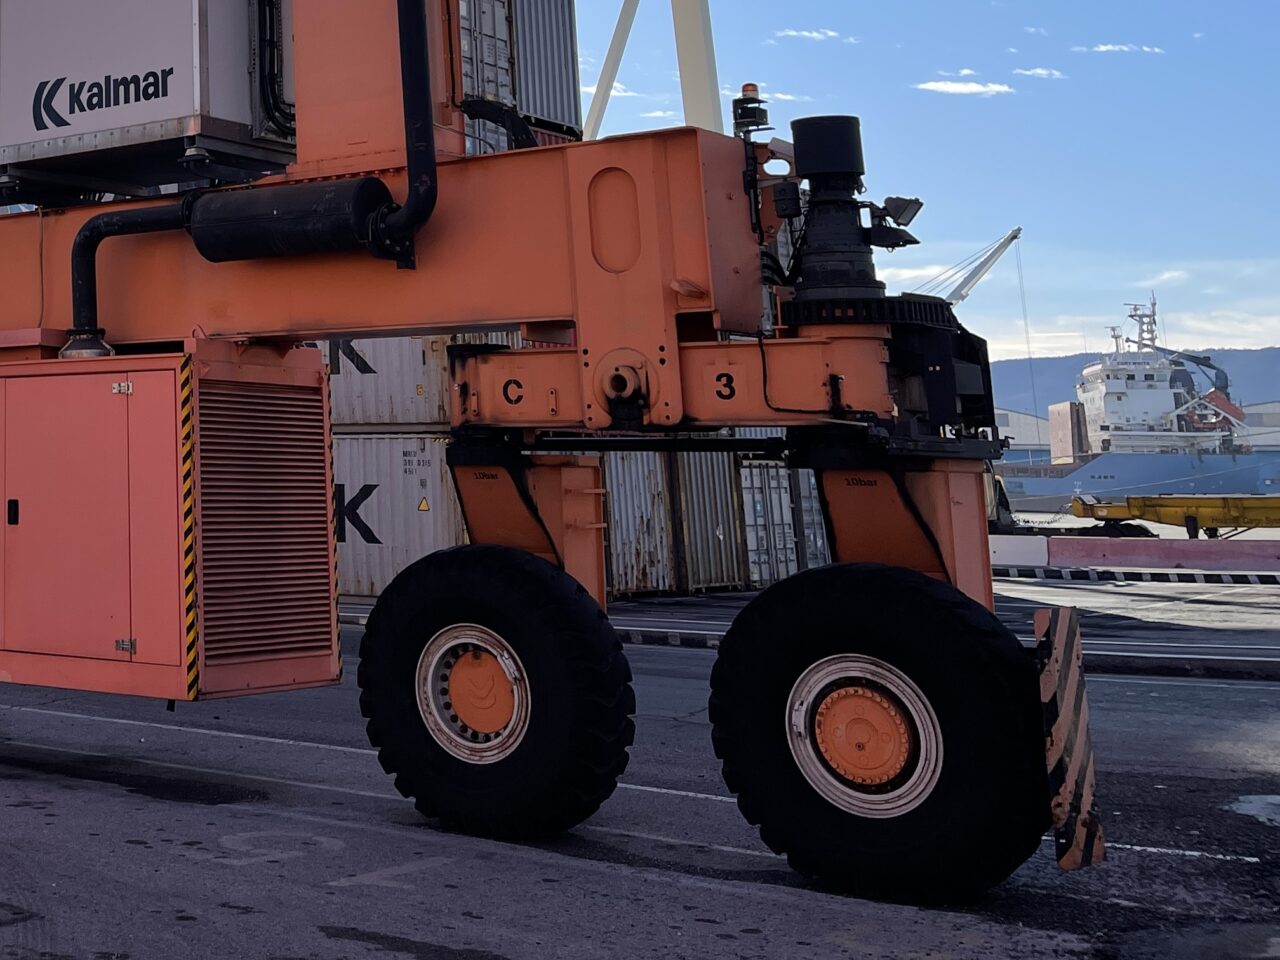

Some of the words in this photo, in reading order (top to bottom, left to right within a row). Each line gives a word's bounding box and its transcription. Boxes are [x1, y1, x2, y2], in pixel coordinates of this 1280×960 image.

[68, 67, 174, 114] Kalmar
[503, 379, 524, 405] C
[715, 373, 736, 400] 3
[334, 484, 383, 544] K
